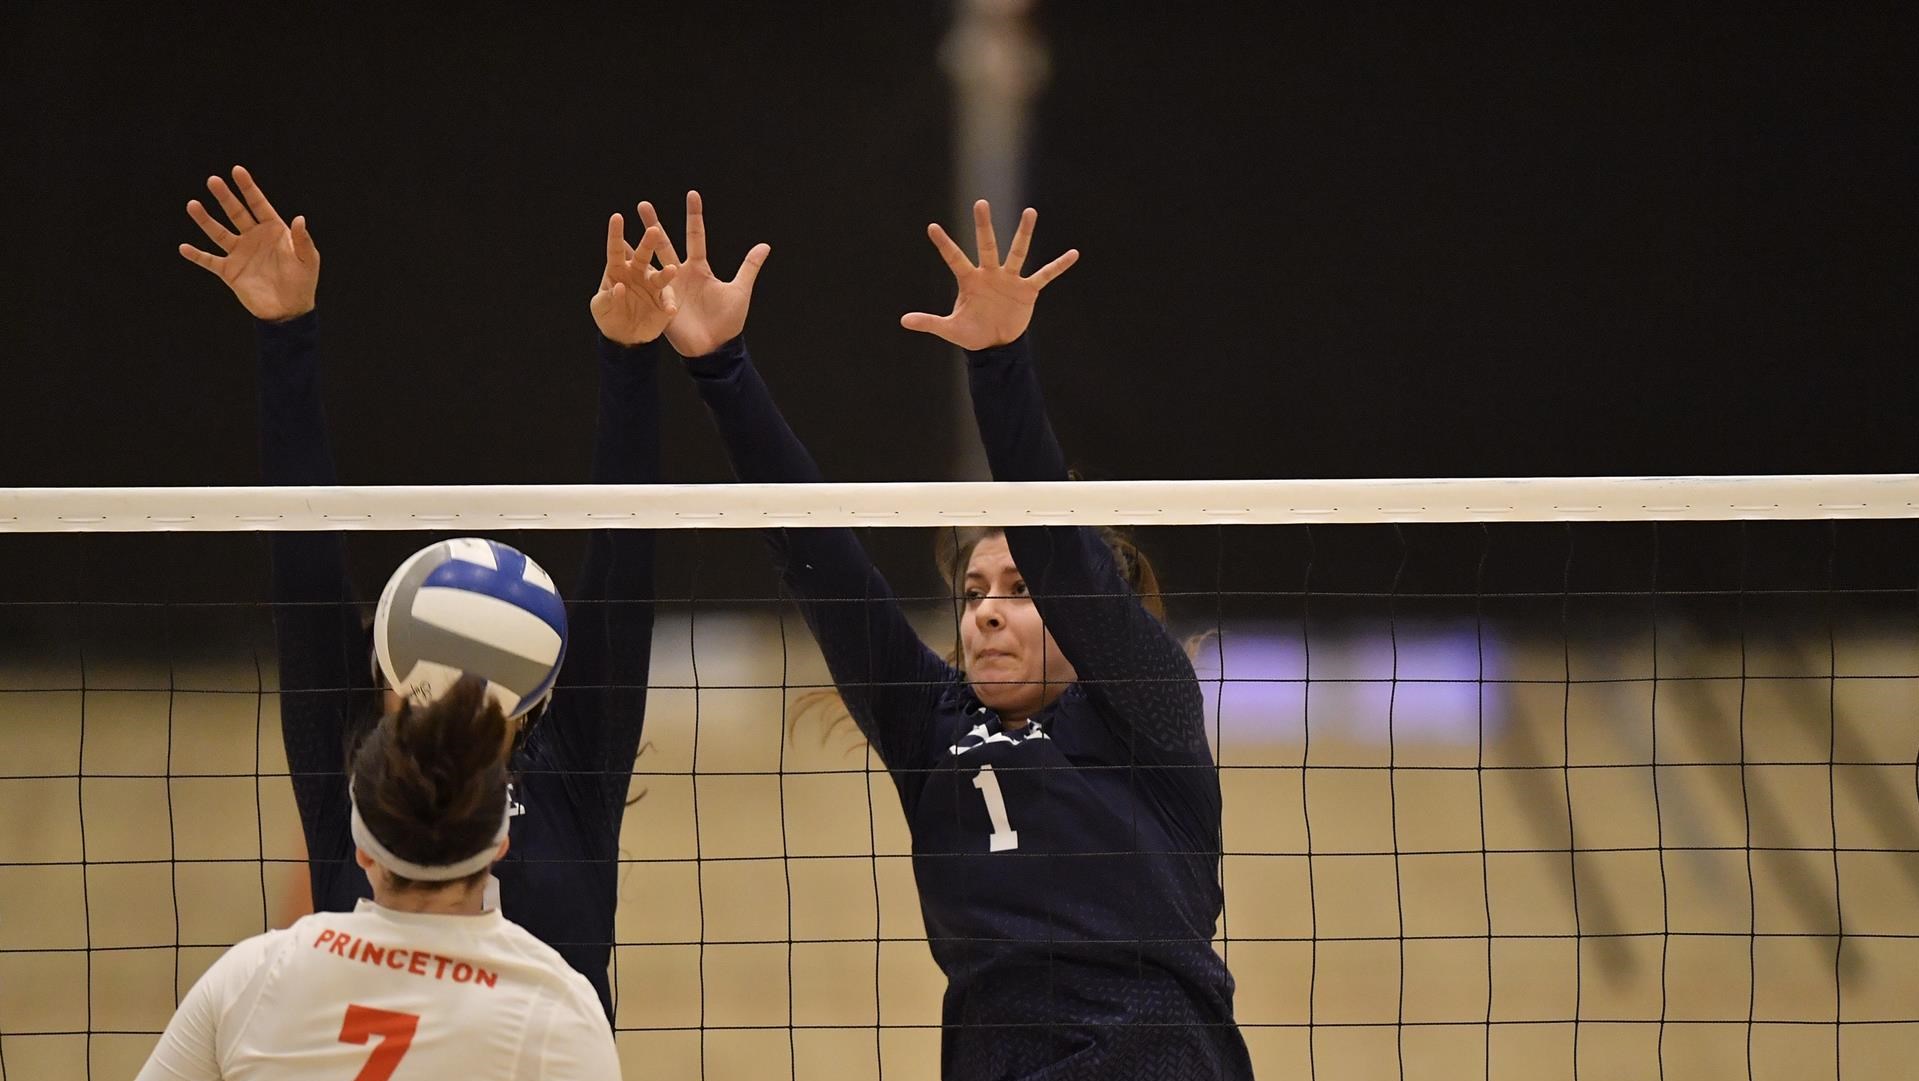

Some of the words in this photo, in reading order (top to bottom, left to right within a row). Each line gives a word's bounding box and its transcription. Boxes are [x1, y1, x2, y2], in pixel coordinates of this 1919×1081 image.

[972, 763, 1019, 853] 1
[313, 929, 499, 989] PRINCETON
[338, 1003, 420, 1081] 7
